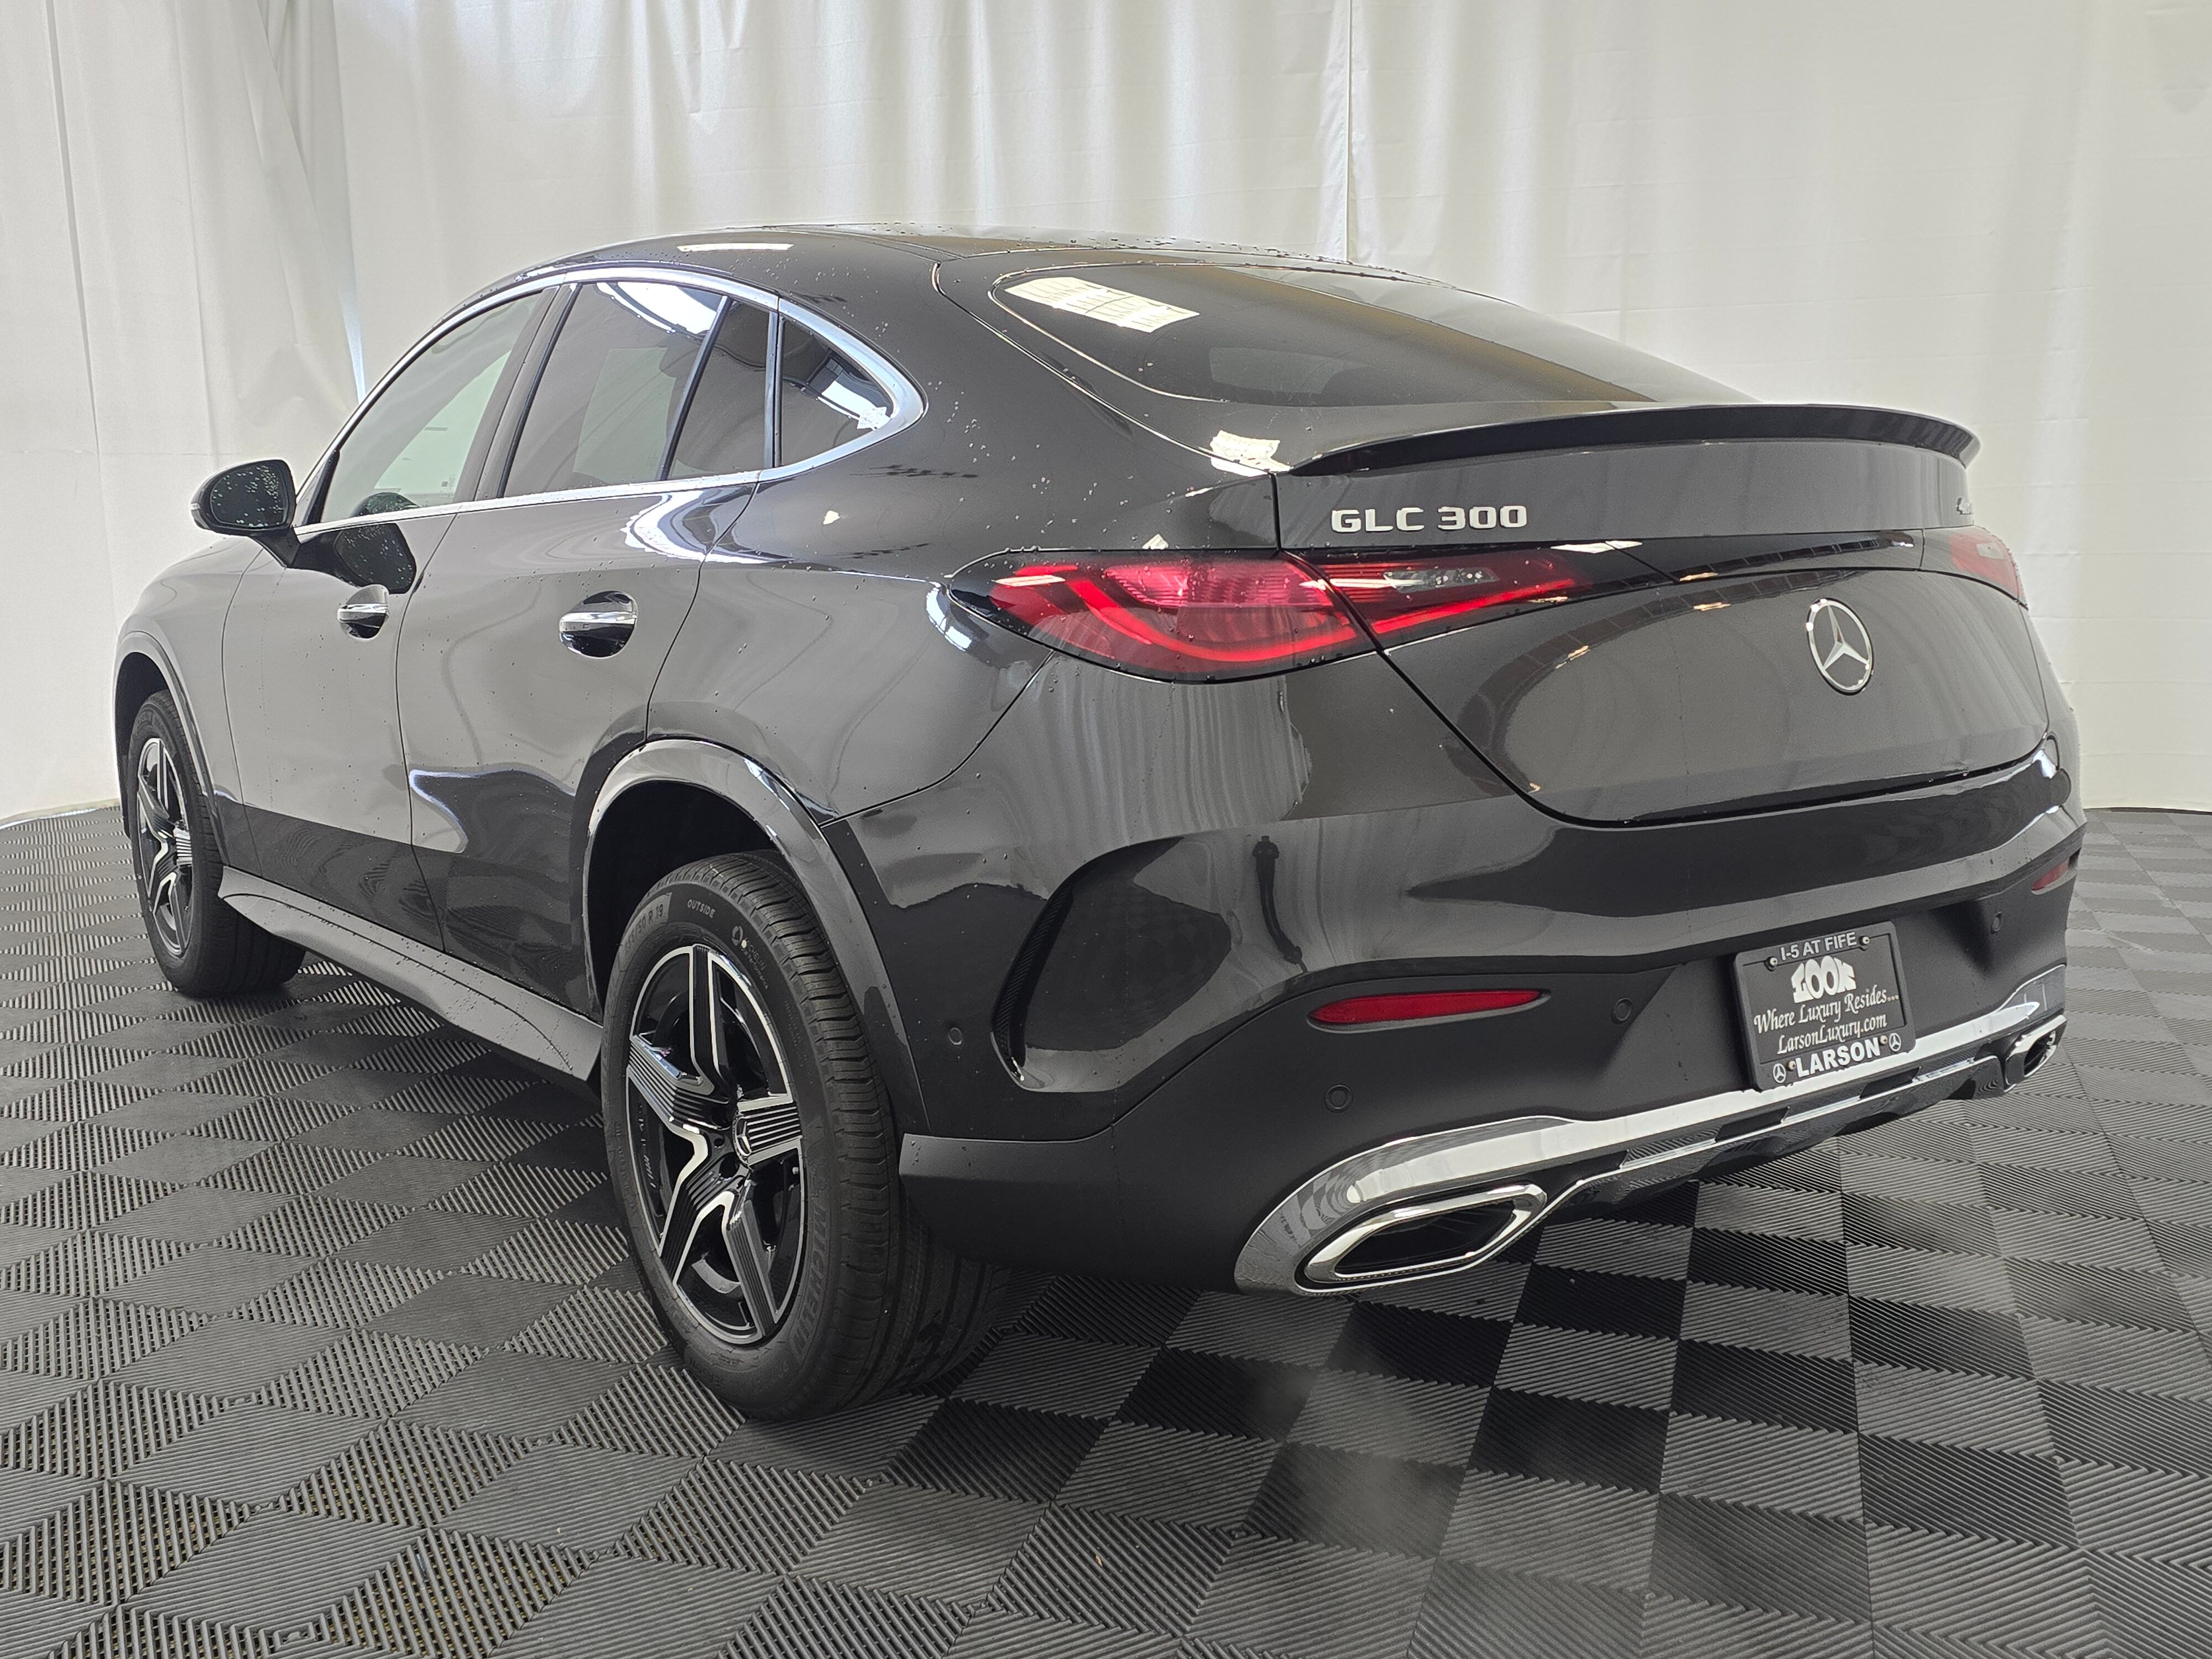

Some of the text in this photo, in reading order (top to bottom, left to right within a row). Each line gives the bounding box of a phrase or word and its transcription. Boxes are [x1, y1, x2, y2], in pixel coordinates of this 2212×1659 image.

[1331, 505, 1527, 533] GLC 300
[655, 904, 664, 919] 19
[687, 899, 716, 919] OUTSIDE
[1781, 932, 1857, 961] I-5 AT FIFE
[1754, 984, 1900, 1034] Where Luxury Resides...
[1777, 1014, 1887, 1055] LarsonLuxury.com
[1796, 1037, 1880, 1078] LARSON
